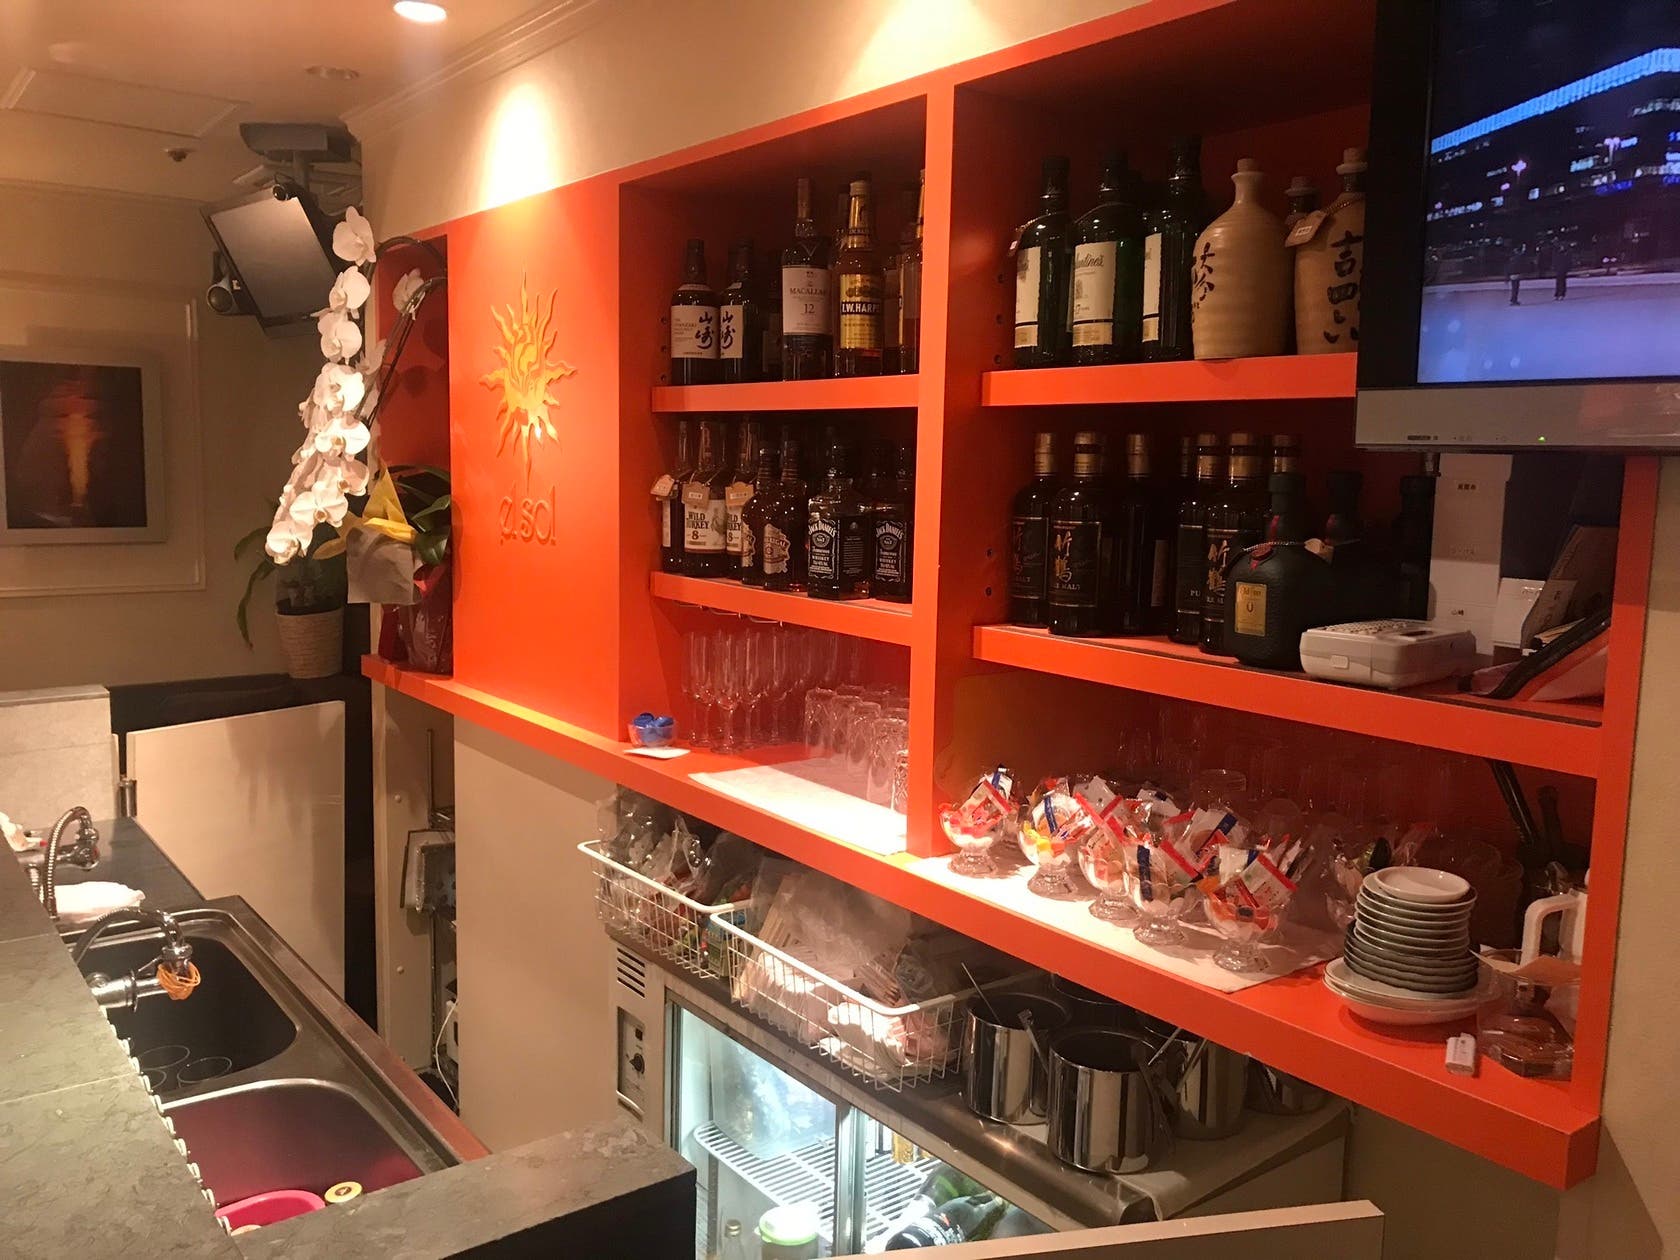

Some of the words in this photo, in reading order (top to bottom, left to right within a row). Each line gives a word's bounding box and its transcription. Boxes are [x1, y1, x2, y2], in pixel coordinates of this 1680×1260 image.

[803, 303, 816, 314] 12
[691, 530, 699, 540] 8
[1189, 589, 1202, 597] PU
